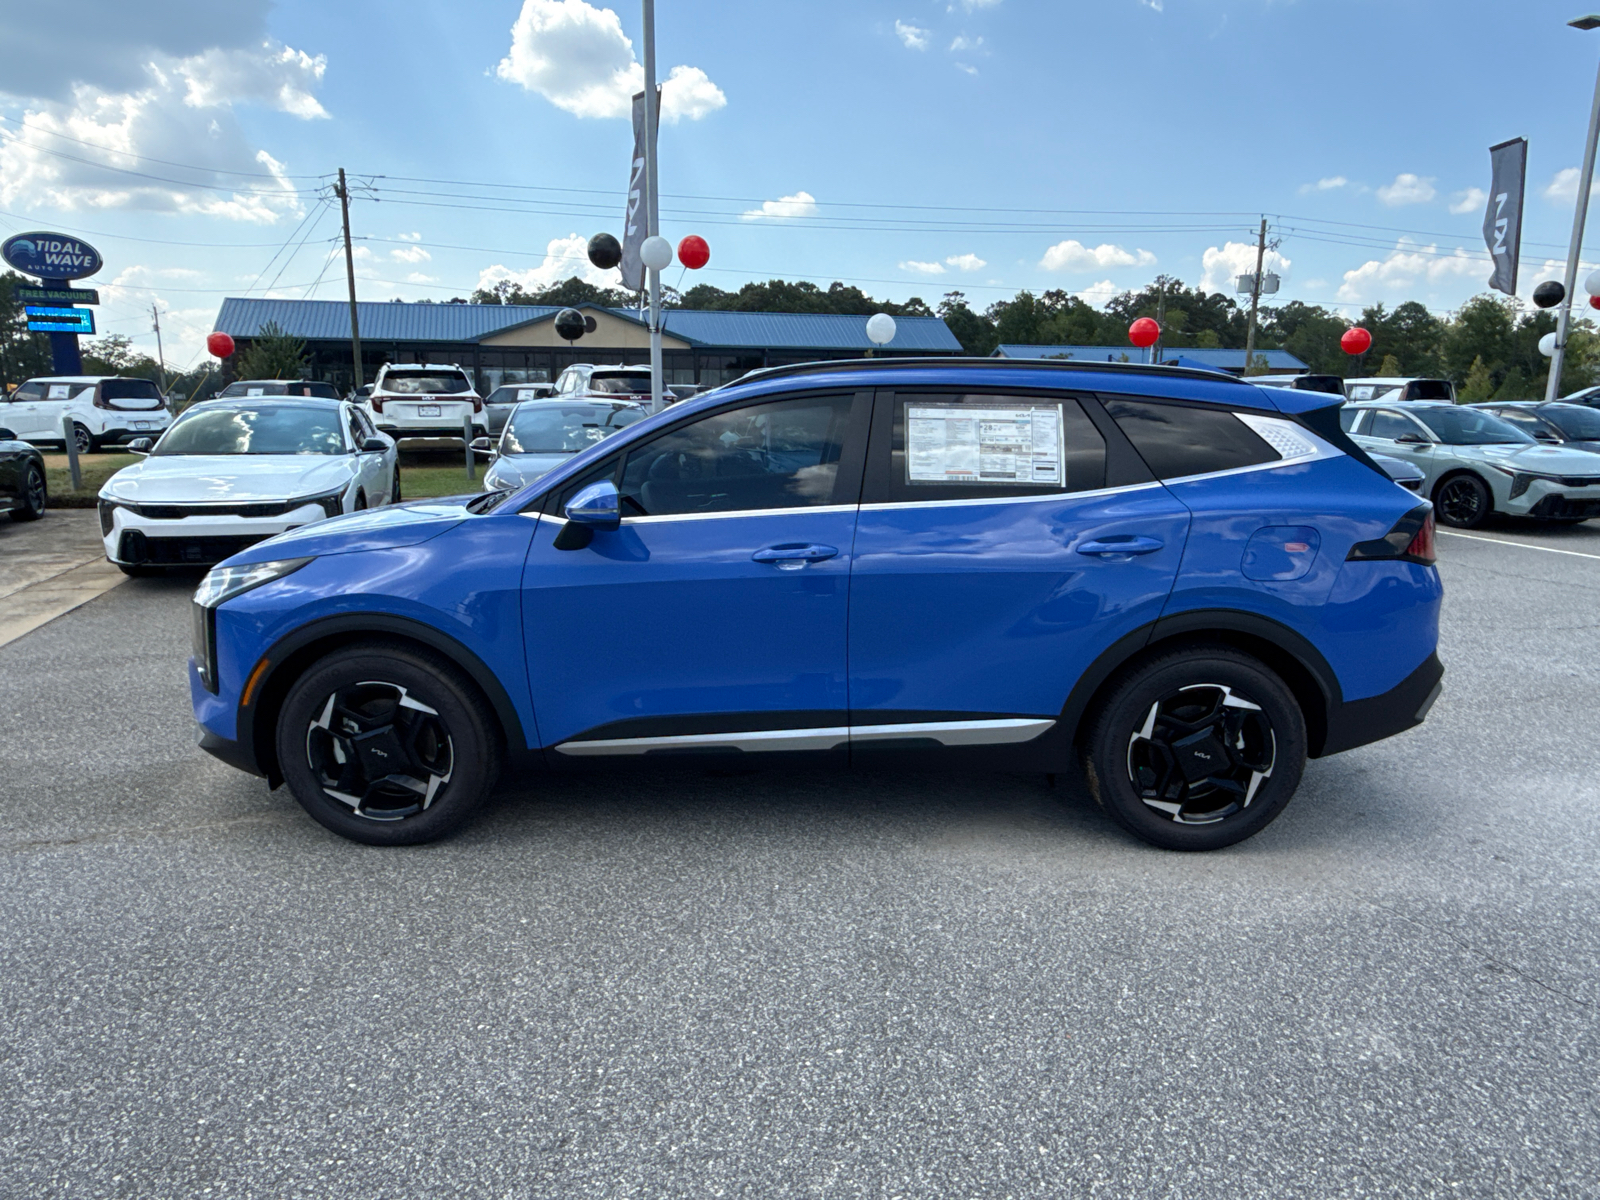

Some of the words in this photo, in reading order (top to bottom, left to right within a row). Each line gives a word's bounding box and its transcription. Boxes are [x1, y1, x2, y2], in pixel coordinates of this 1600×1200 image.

[36, 240, 82, 255] TIDAL
[45, 253, 93, 267] WAVE
[19, 289, 45, 298] FREE
[47, 291, 94, 301] VACUUMS
